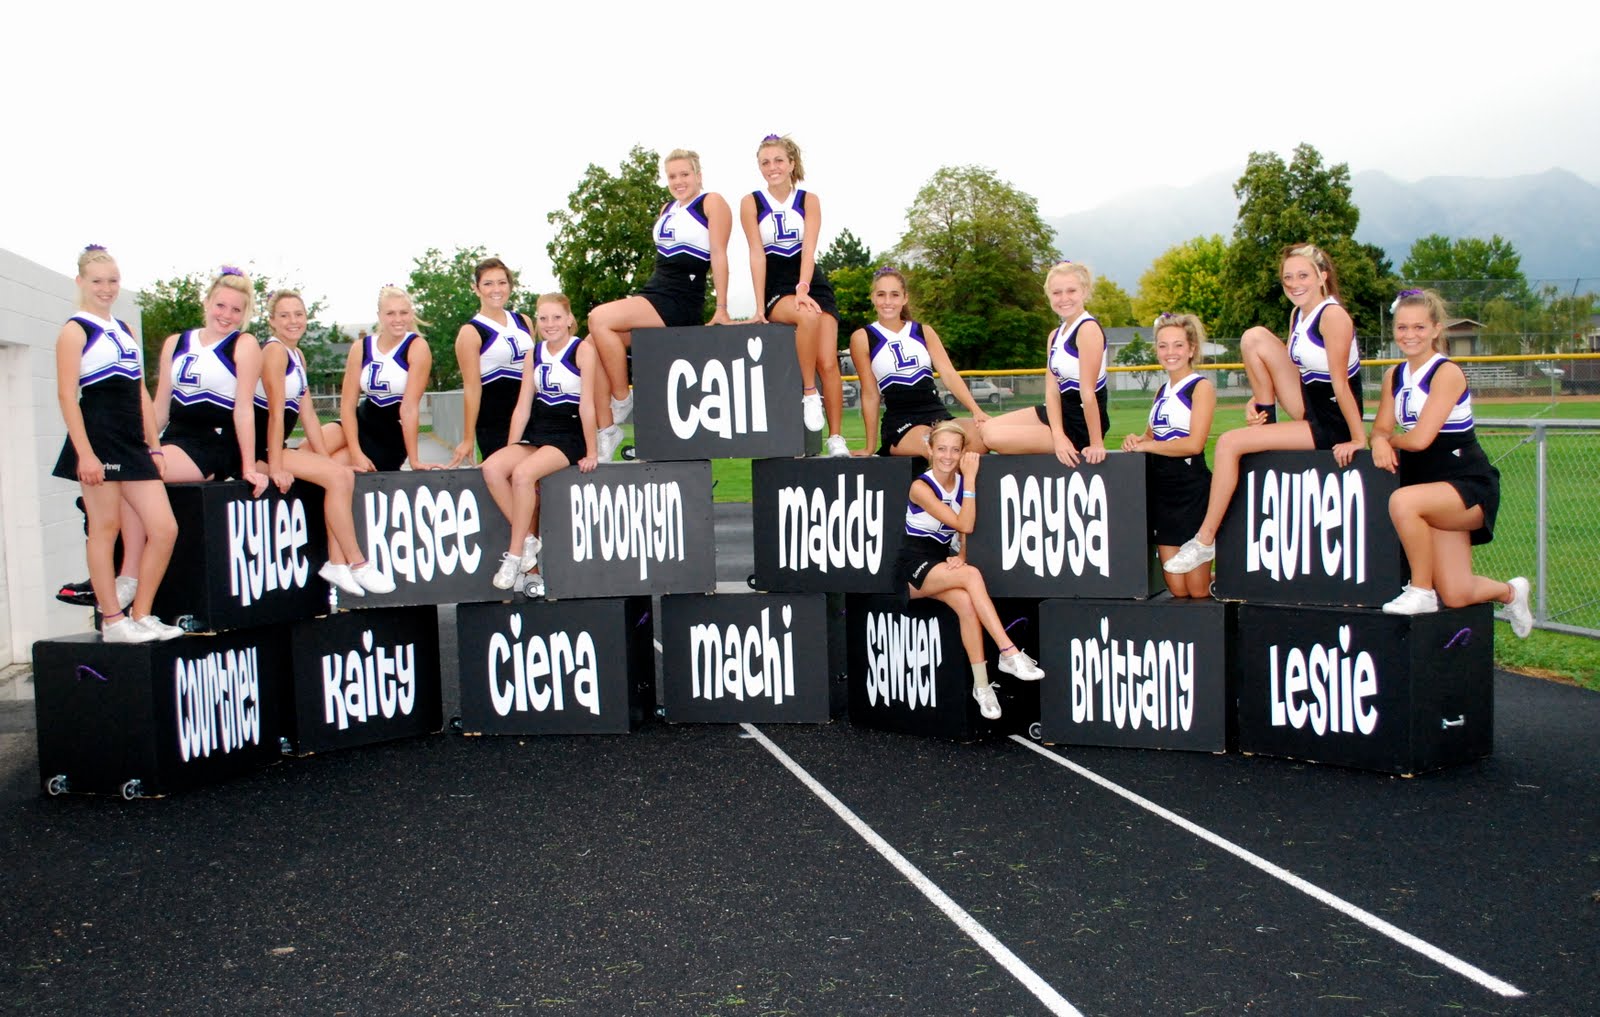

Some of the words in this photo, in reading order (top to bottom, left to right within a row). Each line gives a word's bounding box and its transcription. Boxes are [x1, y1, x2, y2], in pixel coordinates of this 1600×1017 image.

[657, 212, 676, 242] L
[771, 210, 800, 244] L
[103, 328, 139, 363] L
[502, 334, 529, 365] L
[888, 340, 920, 372] L
[176, 352, 201, 388] L
[366, 360, 391, 394] L
[538, 362, 563, 395] L
[1150, 396, 1171, 429] L
[1399, 387, 1419, 427] L
[364, 485, 482, 585] Kasee
[570, 480, 685, 581] Brooklyn
[1000, 471, 1110, 578] Daysa
[1246, 468, 1366, 584] Lauren
[322, 629, 416, 730] Kaity
[1070, 616, 1195, 732] Brittany
[1269, 624, 1379, 736] Leslie
